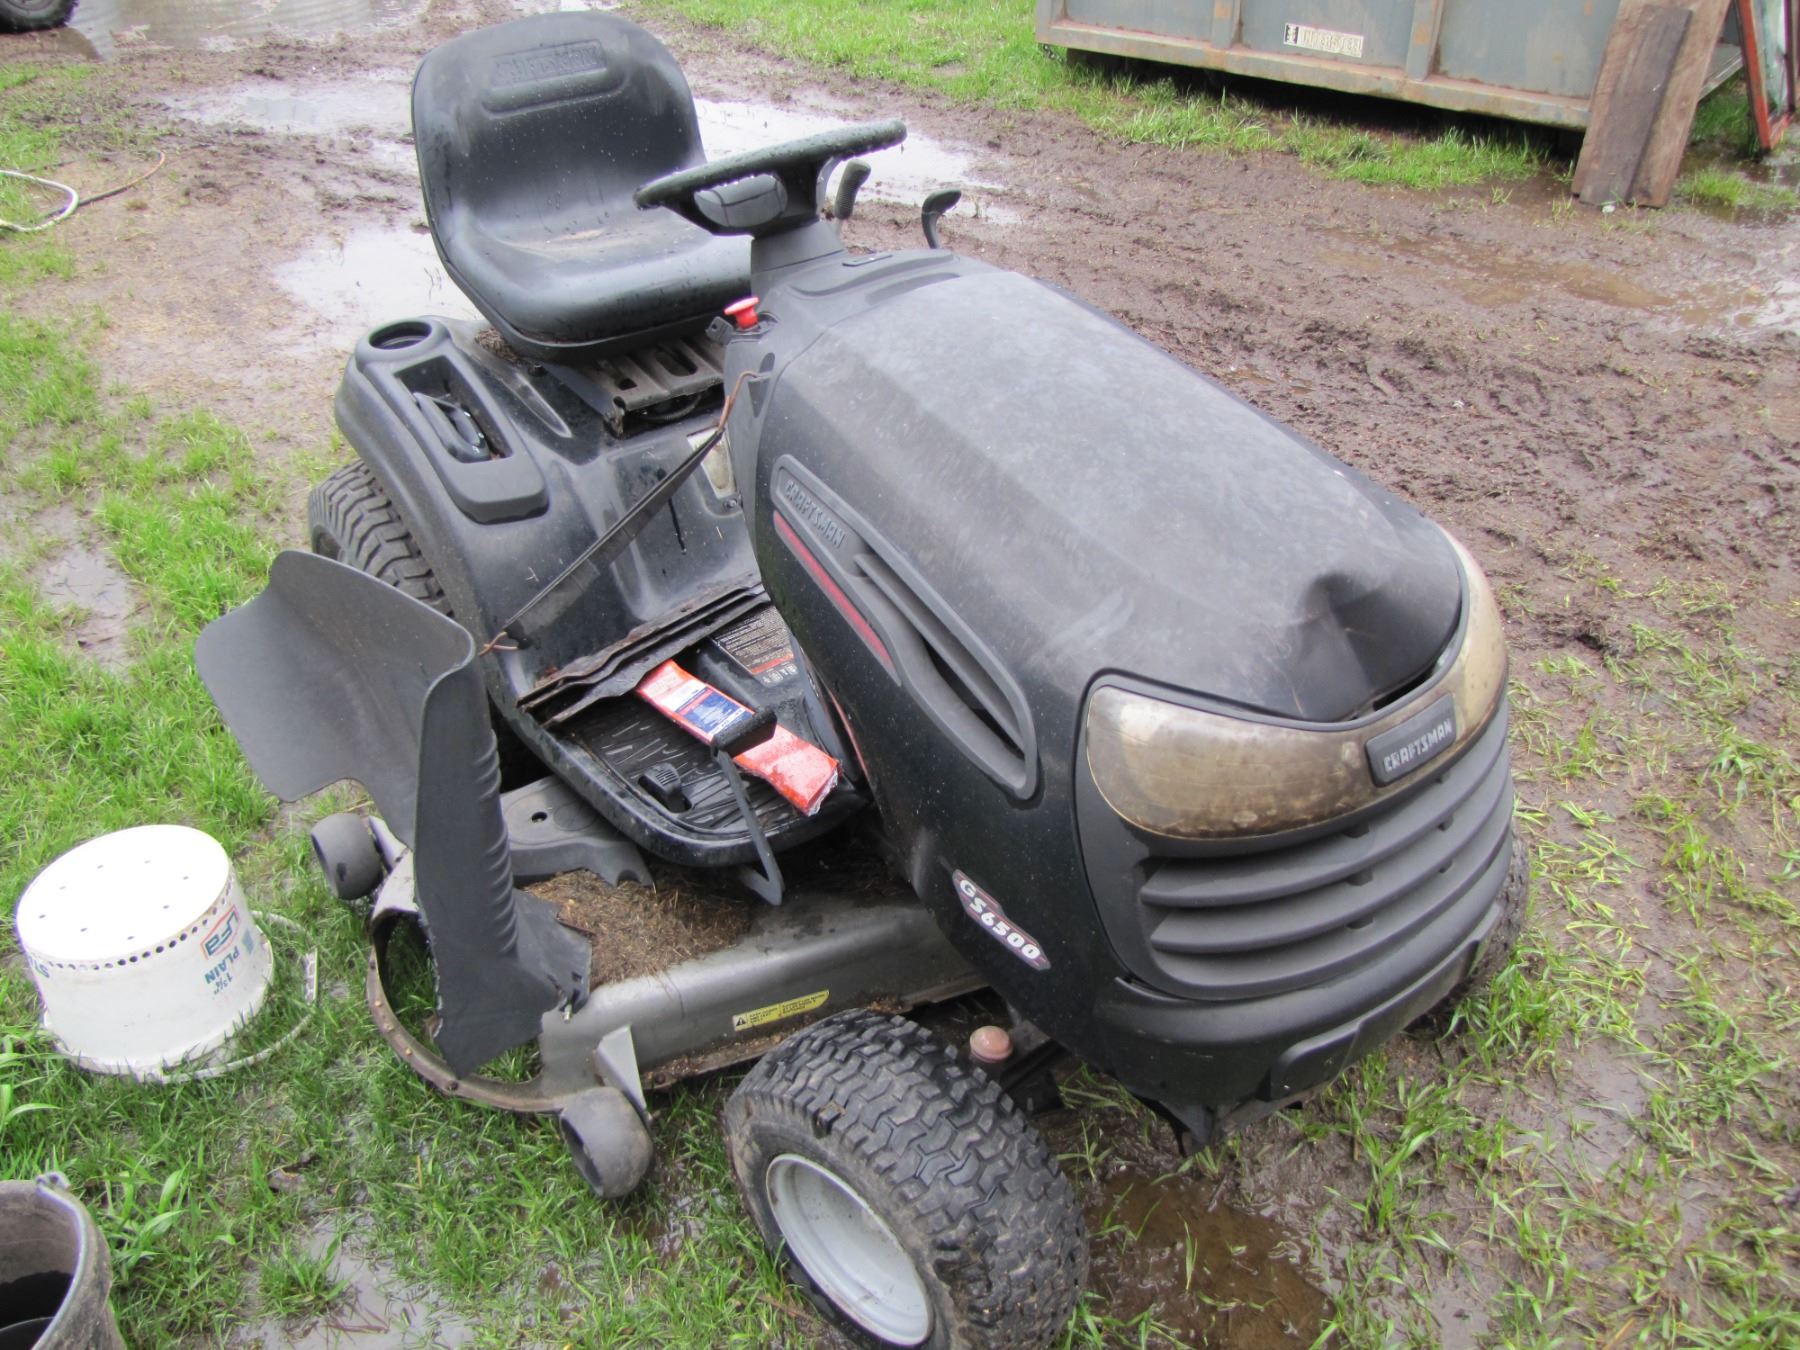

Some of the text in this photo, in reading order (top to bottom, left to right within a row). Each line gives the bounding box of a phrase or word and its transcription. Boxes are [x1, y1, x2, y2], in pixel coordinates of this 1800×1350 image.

[1383, 718, 1453, 772] CRAFTSMAN
[960, 879, 1041, 959] GS6500
[204, 945, 240, 984] PLAIN
